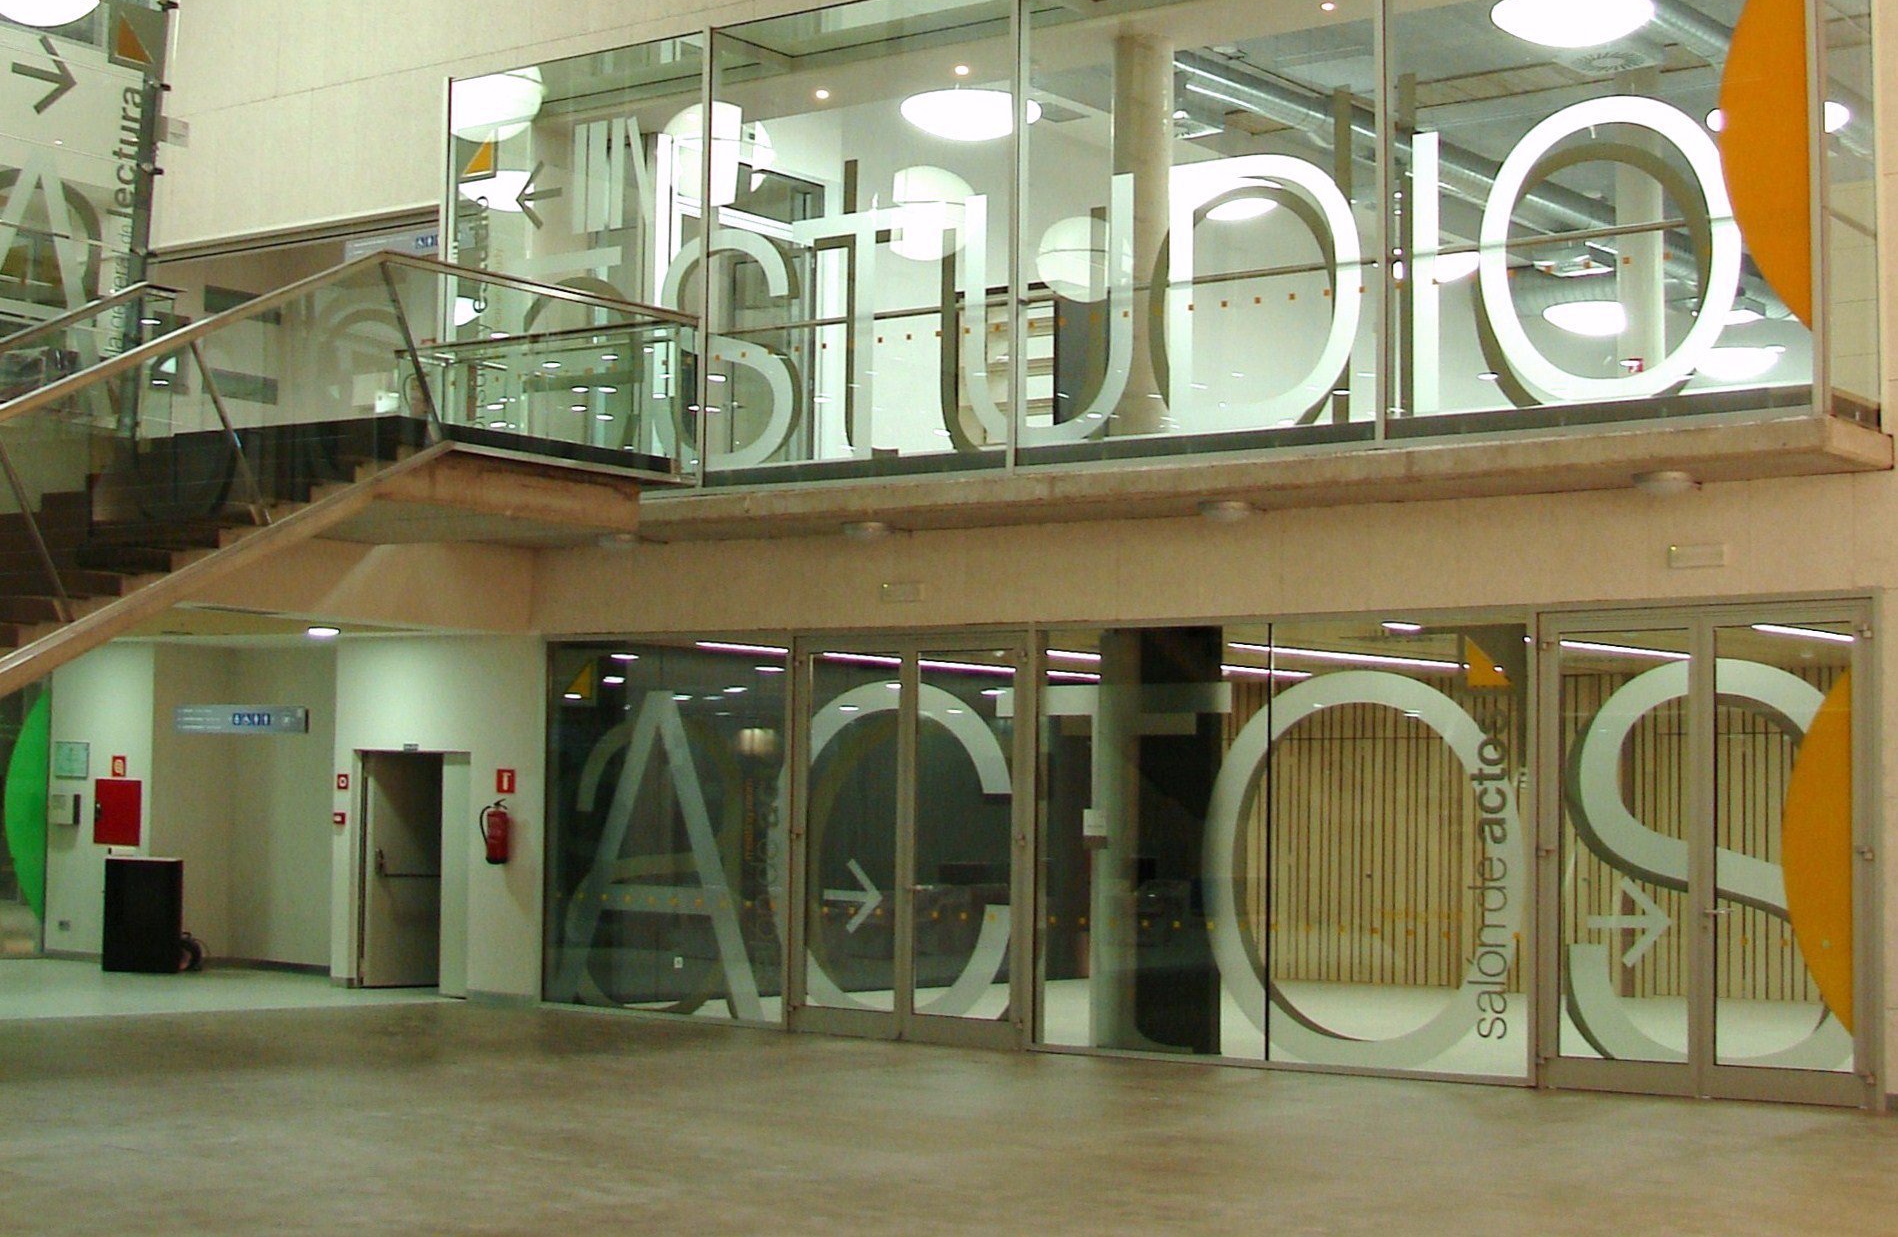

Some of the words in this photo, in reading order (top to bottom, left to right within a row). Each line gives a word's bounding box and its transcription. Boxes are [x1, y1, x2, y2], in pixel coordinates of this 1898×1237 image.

[106, 85, 143, 218] lectura
[108, 249, 130, 329] geeral
[1469, 707, 1509, 845] actos
[556, 657, 1855, 1076] ACTOS
[1467, 856, 1508, 912] de
[1467, 924, 1508, 1040] salón
